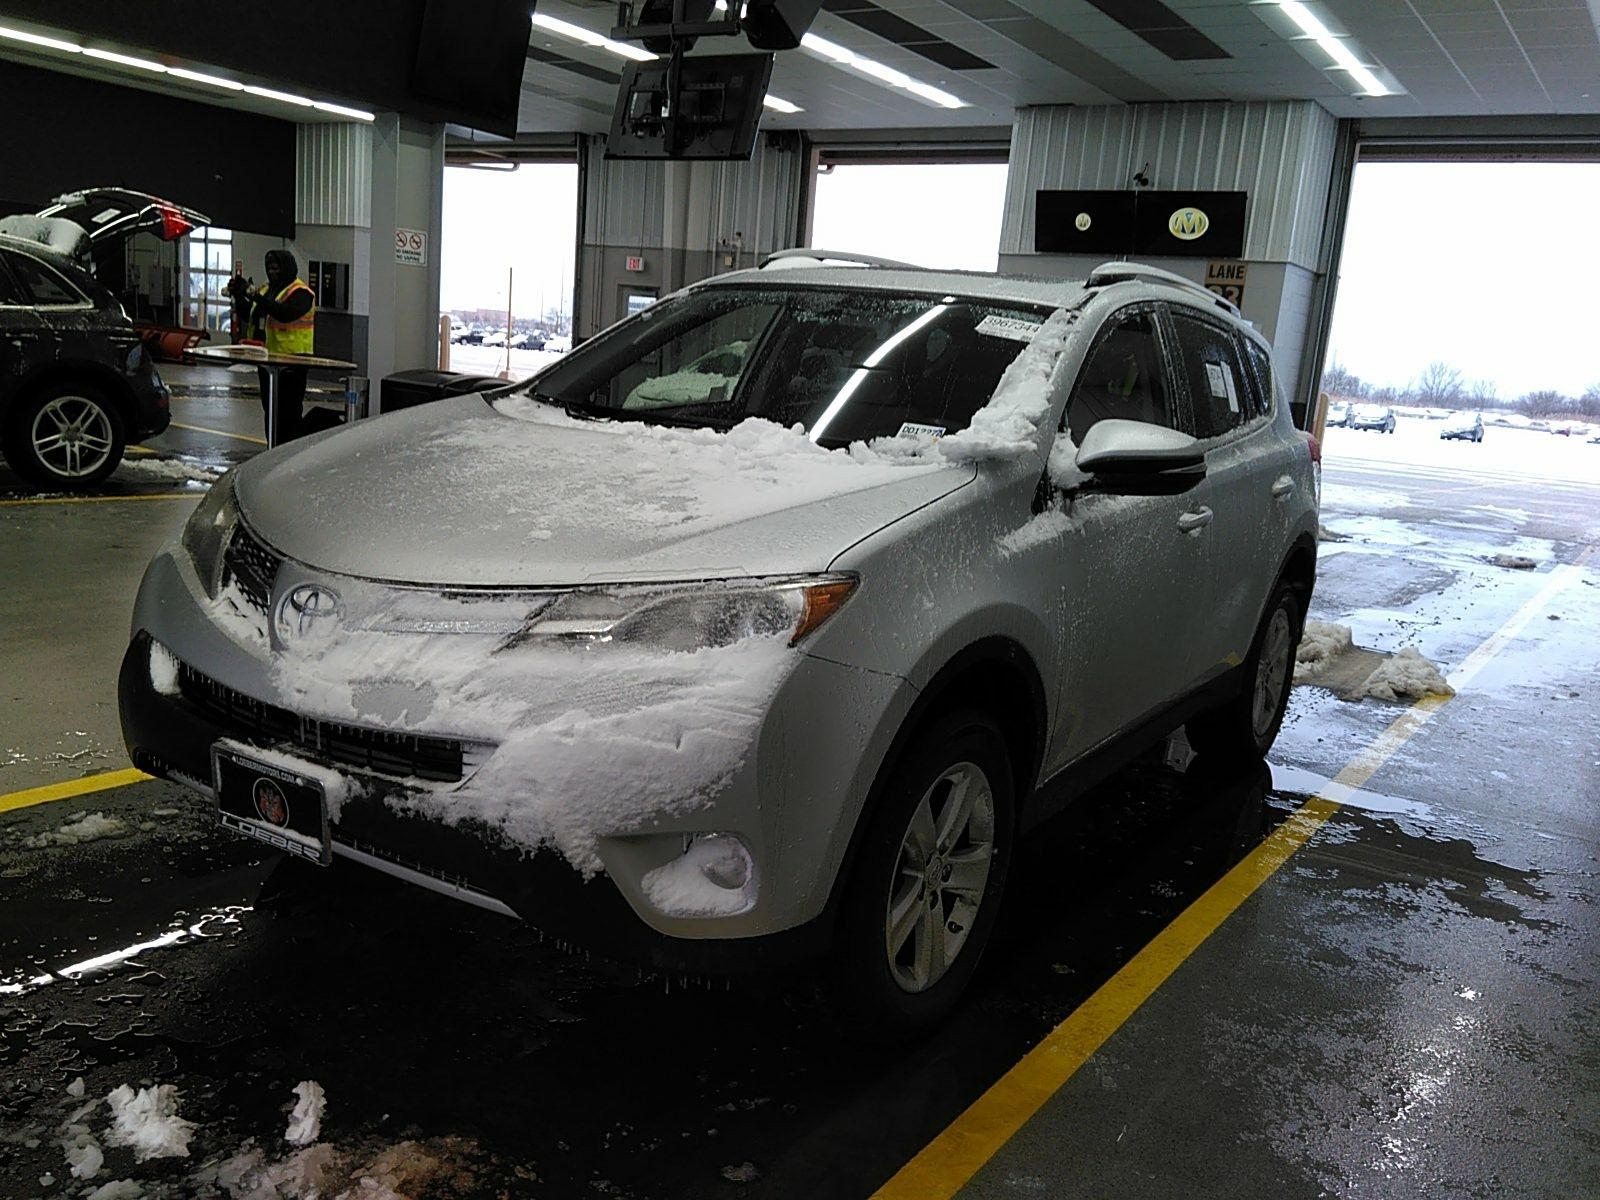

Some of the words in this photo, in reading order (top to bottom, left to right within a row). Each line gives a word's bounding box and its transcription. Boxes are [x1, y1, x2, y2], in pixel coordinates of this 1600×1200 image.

[628, 258, 640, 269] EXIT
[1208, 264, 1245, 280] LANE
[221, 815, 321, 863] LOEBER
